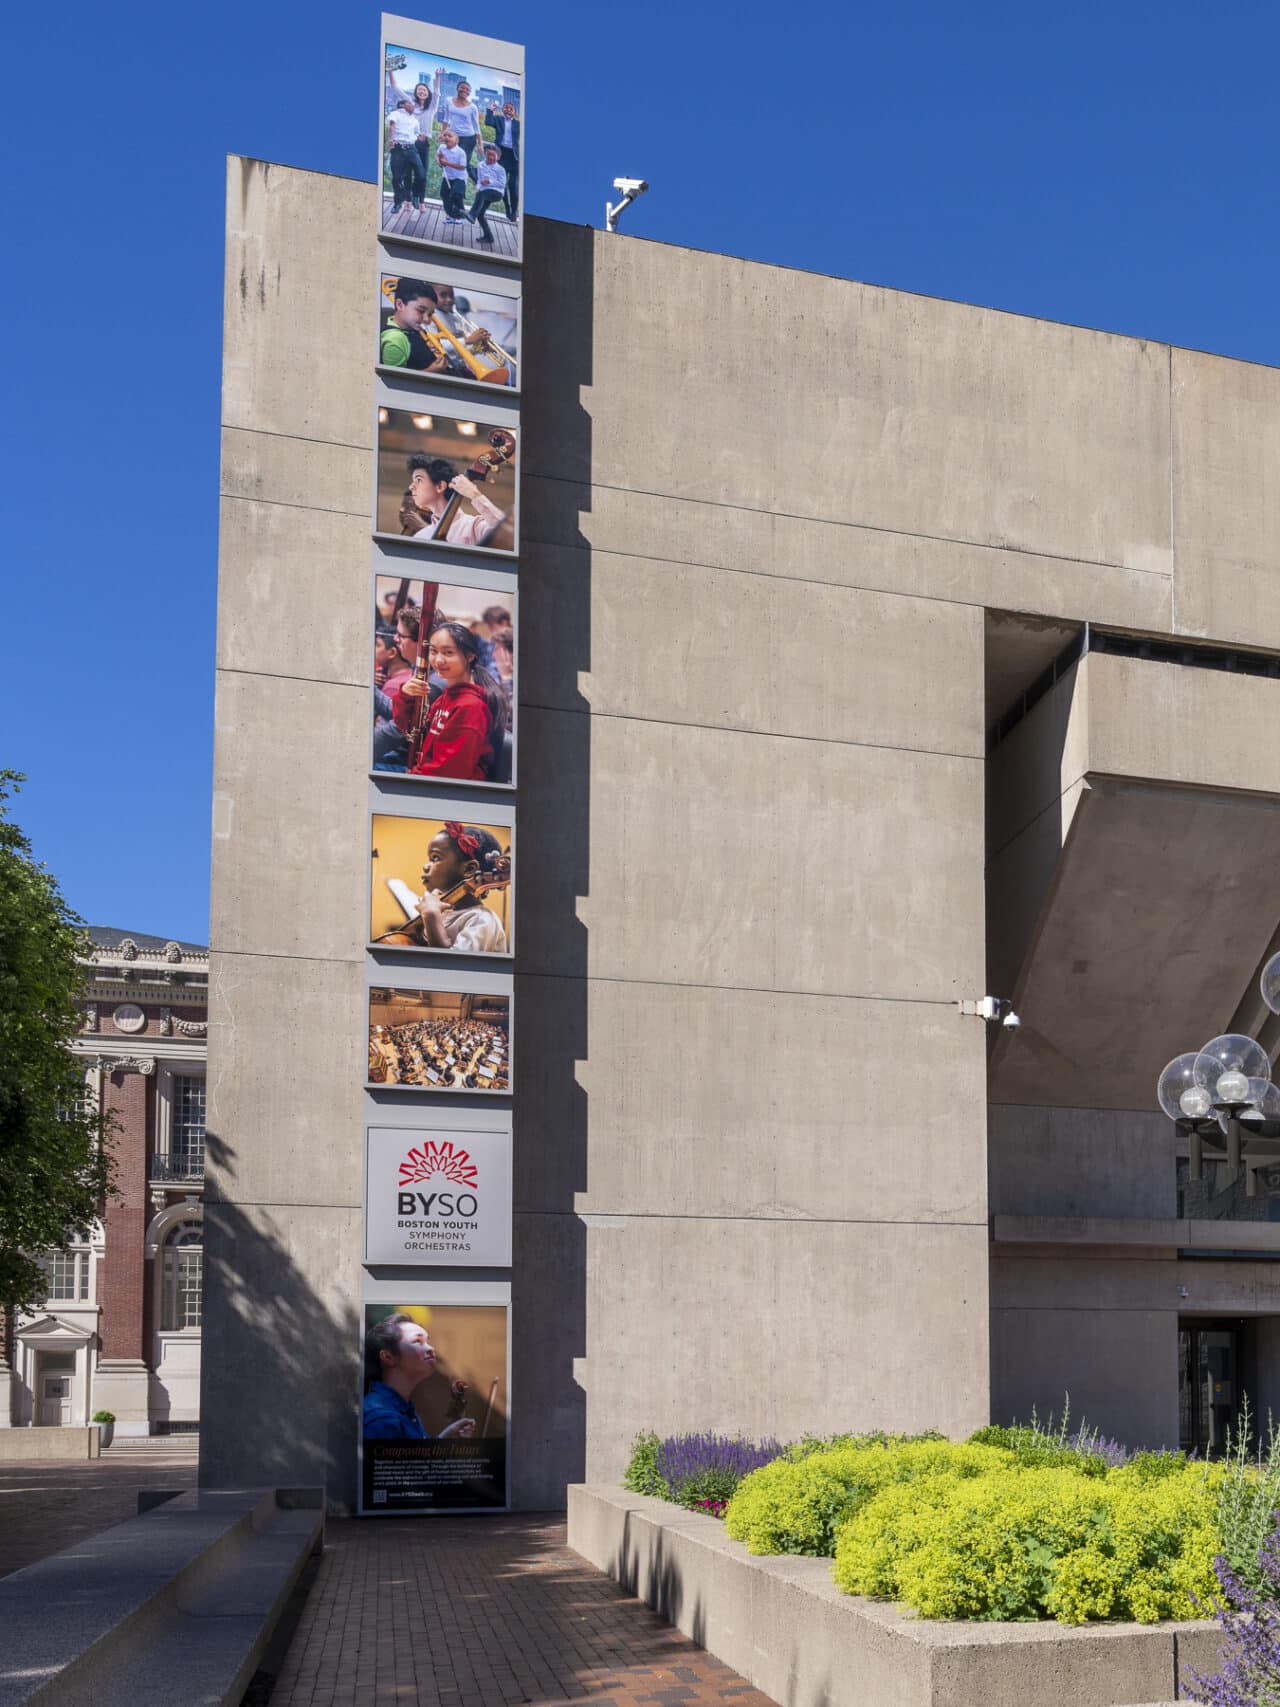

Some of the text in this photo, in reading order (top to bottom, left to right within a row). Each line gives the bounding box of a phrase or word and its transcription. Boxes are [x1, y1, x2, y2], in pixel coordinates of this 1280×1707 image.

[397, 1192, 478, 1217] BYSO
[397, 1220, 478, 1230] BOSTON YOUTH
[409, 1231, 467, 1240] SYMPHONY
[404, 1241, 471, 1251] ORCHESTRAS
